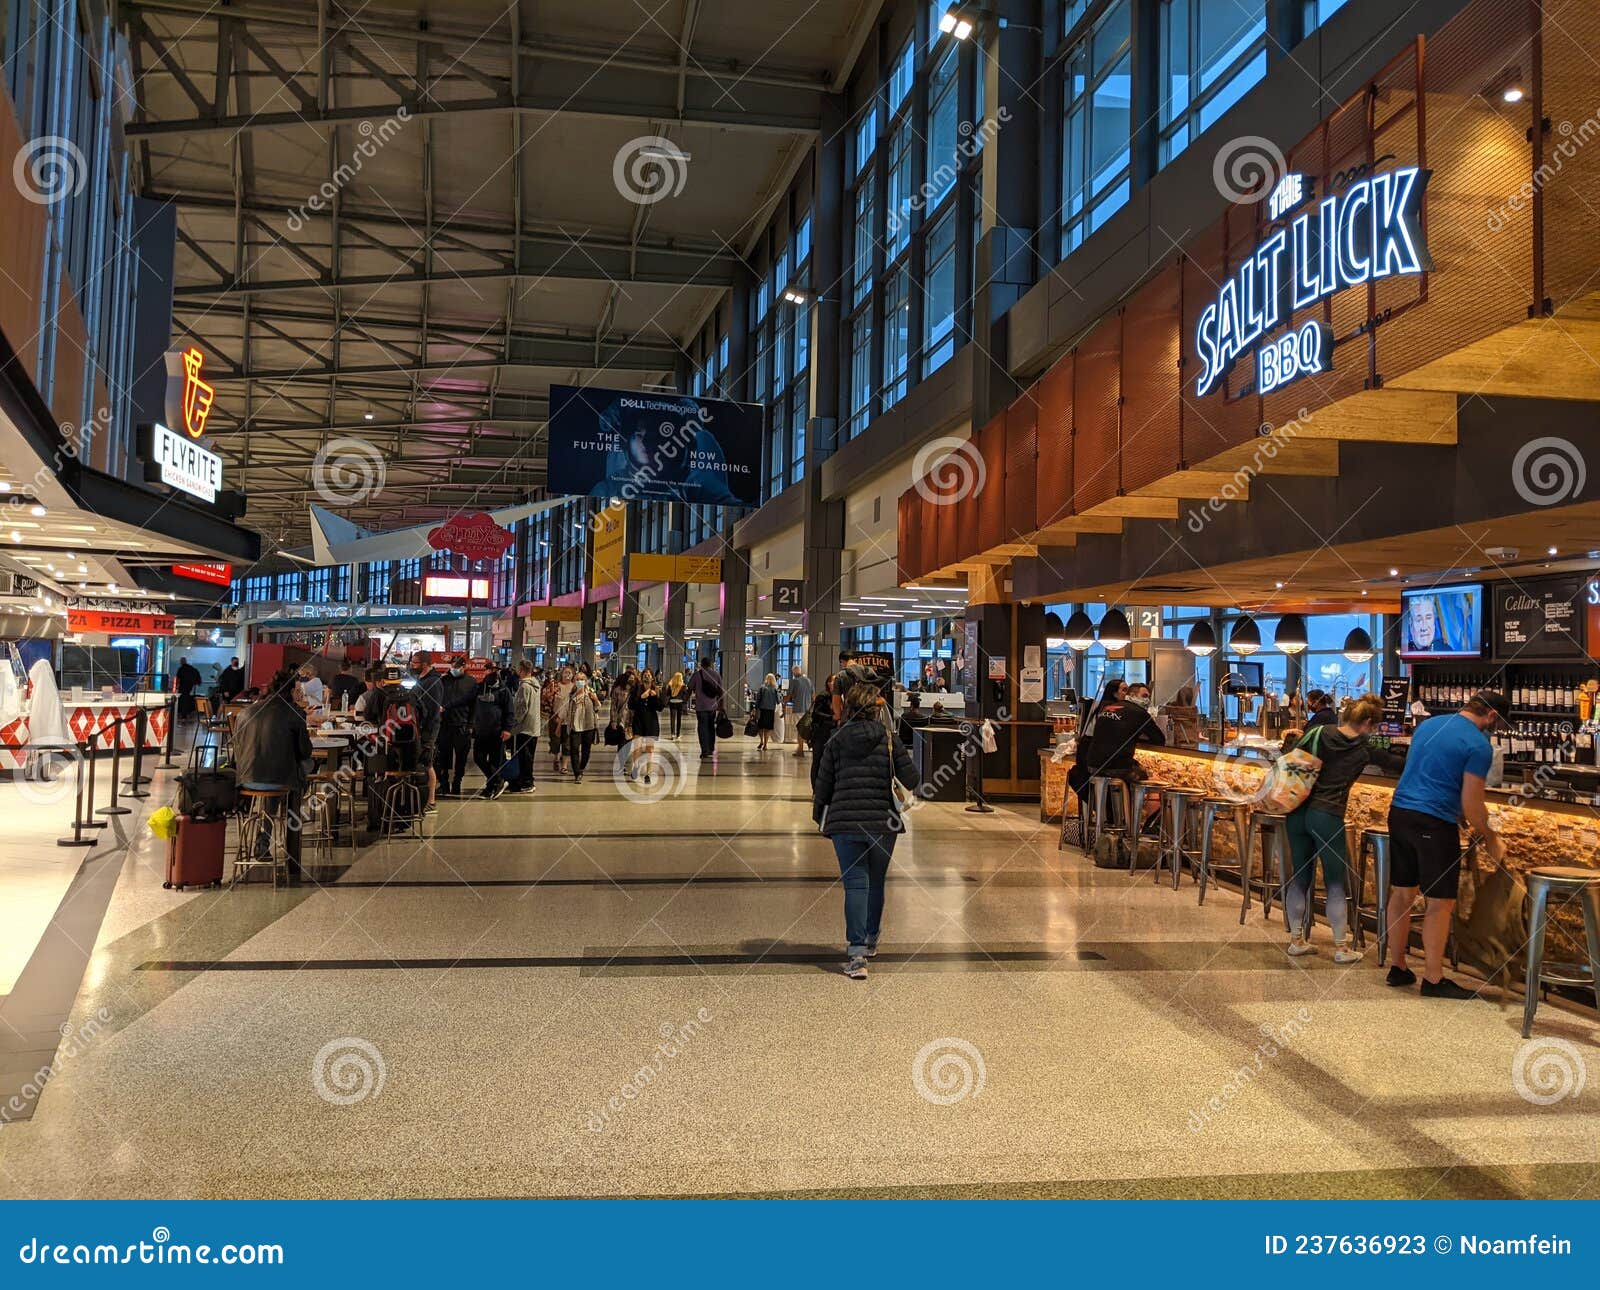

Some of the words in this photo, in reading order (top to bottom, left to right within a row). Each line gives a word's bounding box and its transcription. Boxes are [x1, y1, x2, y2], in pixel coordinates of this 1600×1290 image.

[1269, 172, 1303, 220] THE
[1196, 228, 1286, 397] SALT
[1292, 167, 1423, 310] LICK
[1258, 319, 1323, 396] BBQ
[597, 432, 621, 442] THE
[163, 433, 216, 485] FLYRITE
[690, 450, 716, 460] NOW
[779, 587, 800, 604] 21
[1504, 595, 1541, 611] Cellars
[69, 614, 88, 626] ZA
[101, 616, 141, 629] PIZZA
[1142, 611, 1159, 626] 21
[607, 630, 618, 639] 20
